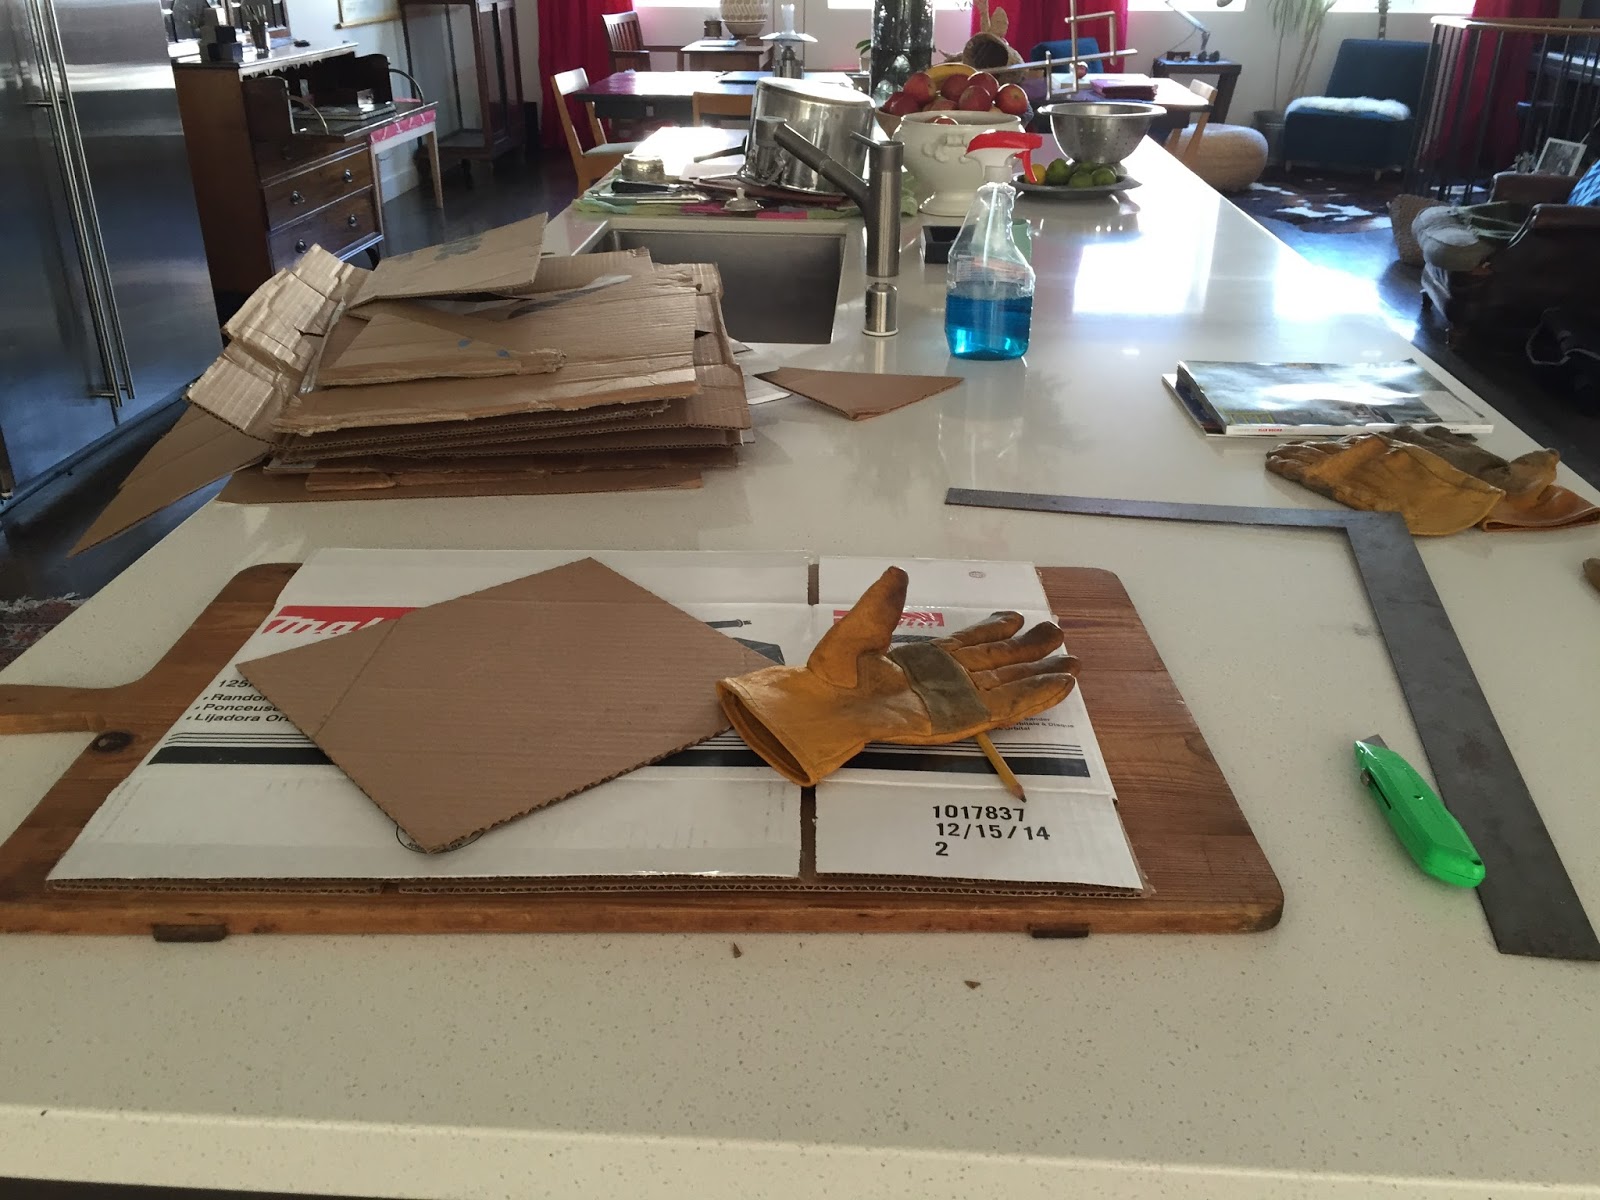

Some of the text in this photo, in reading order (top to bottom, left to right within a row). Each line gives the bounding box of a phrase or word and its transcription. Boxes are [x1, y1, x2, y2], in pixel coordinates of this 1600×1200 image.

[195, 713, 260, 723] Lijadora
[932, 804, 1024, 822] 1017837
[936, 823, 1051, 841] 12/15/14
[934, 841, 949, 857] 2
